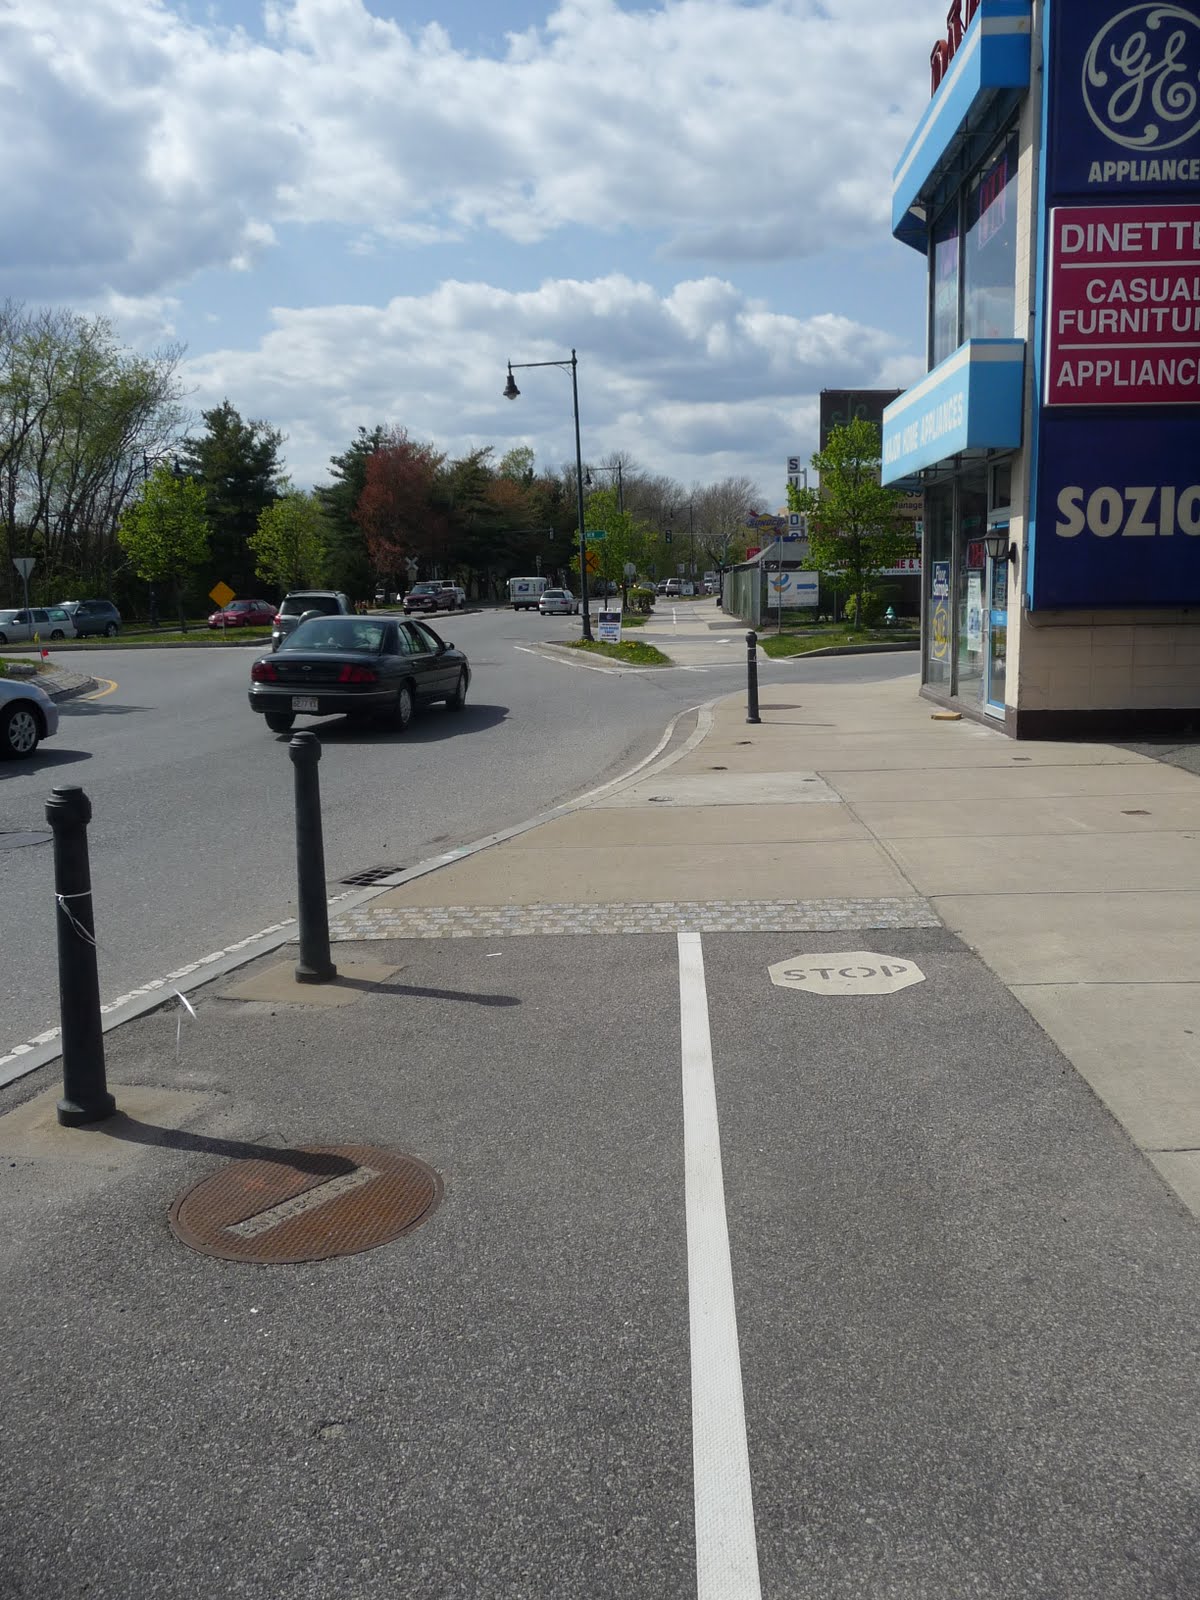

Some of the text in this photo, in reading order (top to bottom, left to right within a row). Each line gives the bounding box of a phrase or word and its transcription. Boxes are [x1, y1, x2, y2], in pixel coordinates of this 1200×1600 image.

[1108, 30, 1197, 123] GE
[1088, 159, 1200, 183] APPLIANCE
[1057, 359, 1200, 387] APPLIANC
[783, 964, 908, 981] STOP
